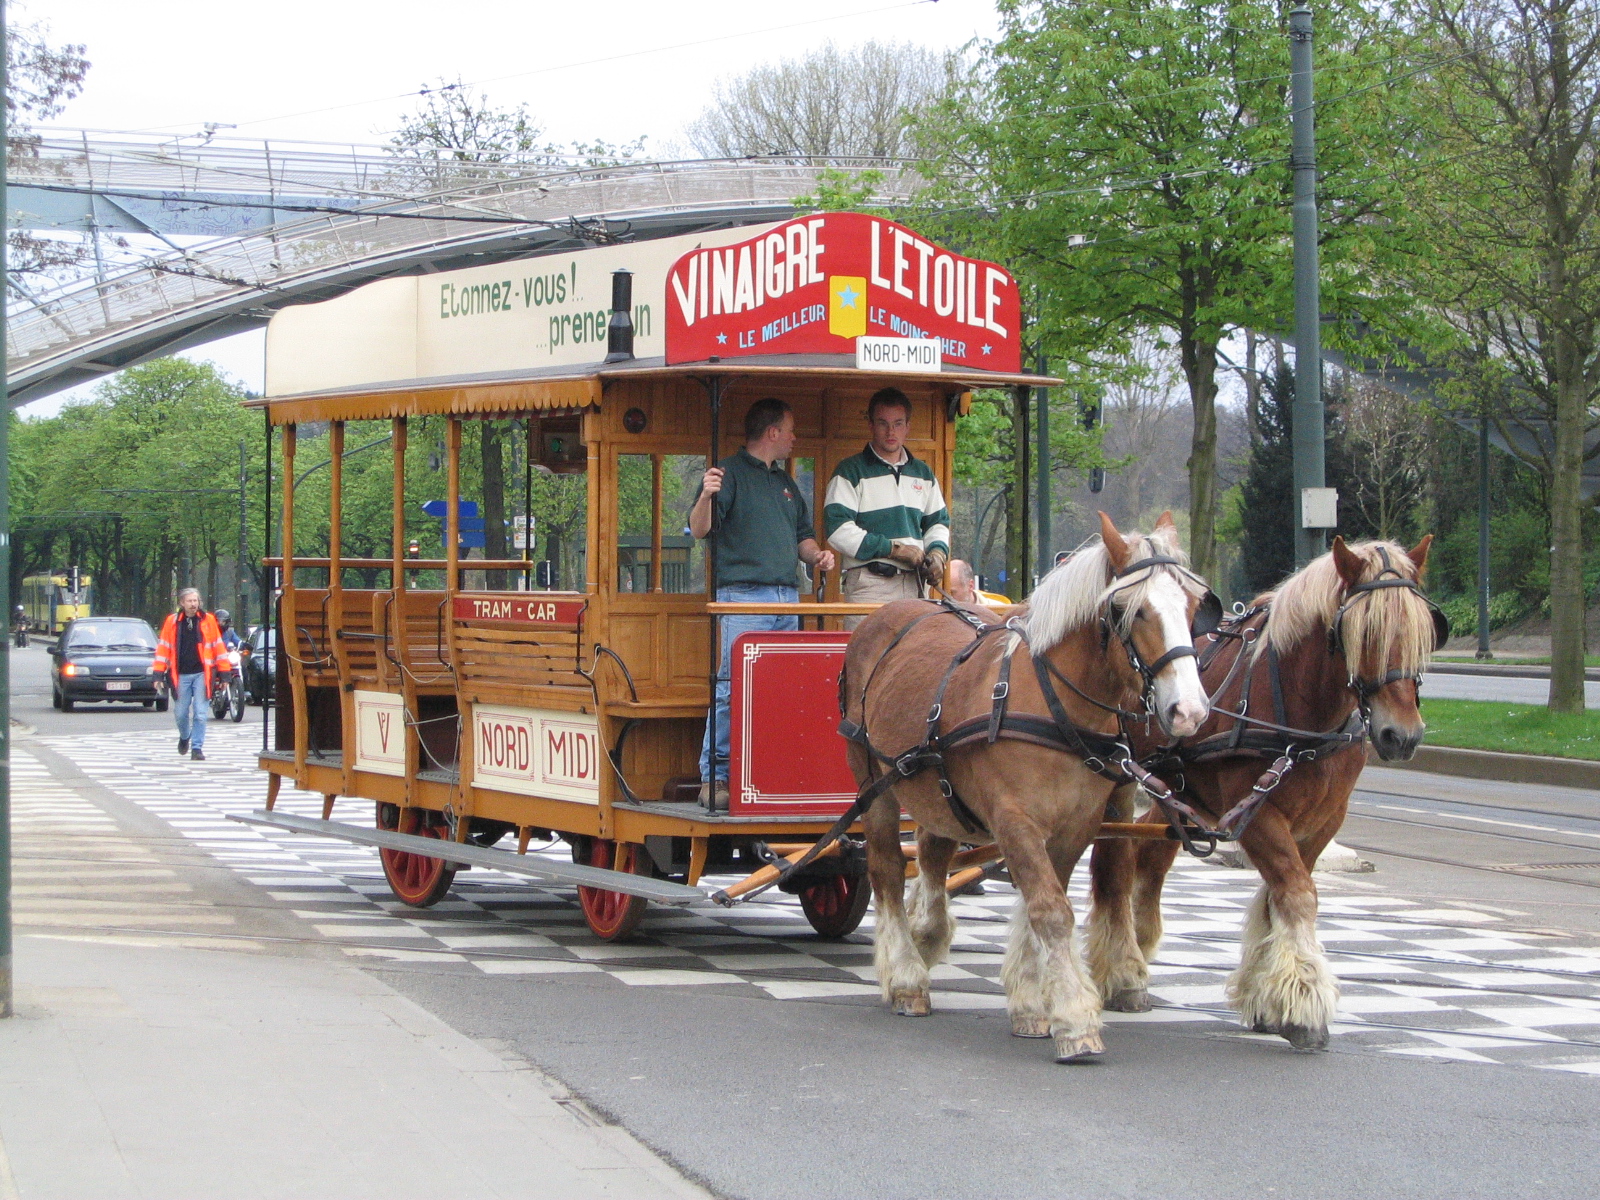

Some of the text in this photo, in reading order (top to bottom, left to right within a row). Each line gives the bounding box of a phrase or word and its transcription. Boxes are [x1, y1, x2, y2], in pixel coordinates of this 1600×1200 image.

[672, 218, 1008, 338] VINAIGRE L'ETOILE
[739, 304, 826, 349] LE MEILLEUR
[869, 305, 886, 326] LE
[933, 336, 966, 358] HER
[863, 342, 936, 365] NORD-MIDI
[473, 600, 512, 619] TRAM
[527, 602, 556, 621] CAR
[481, 721, 597, 781] NORD MIDI
